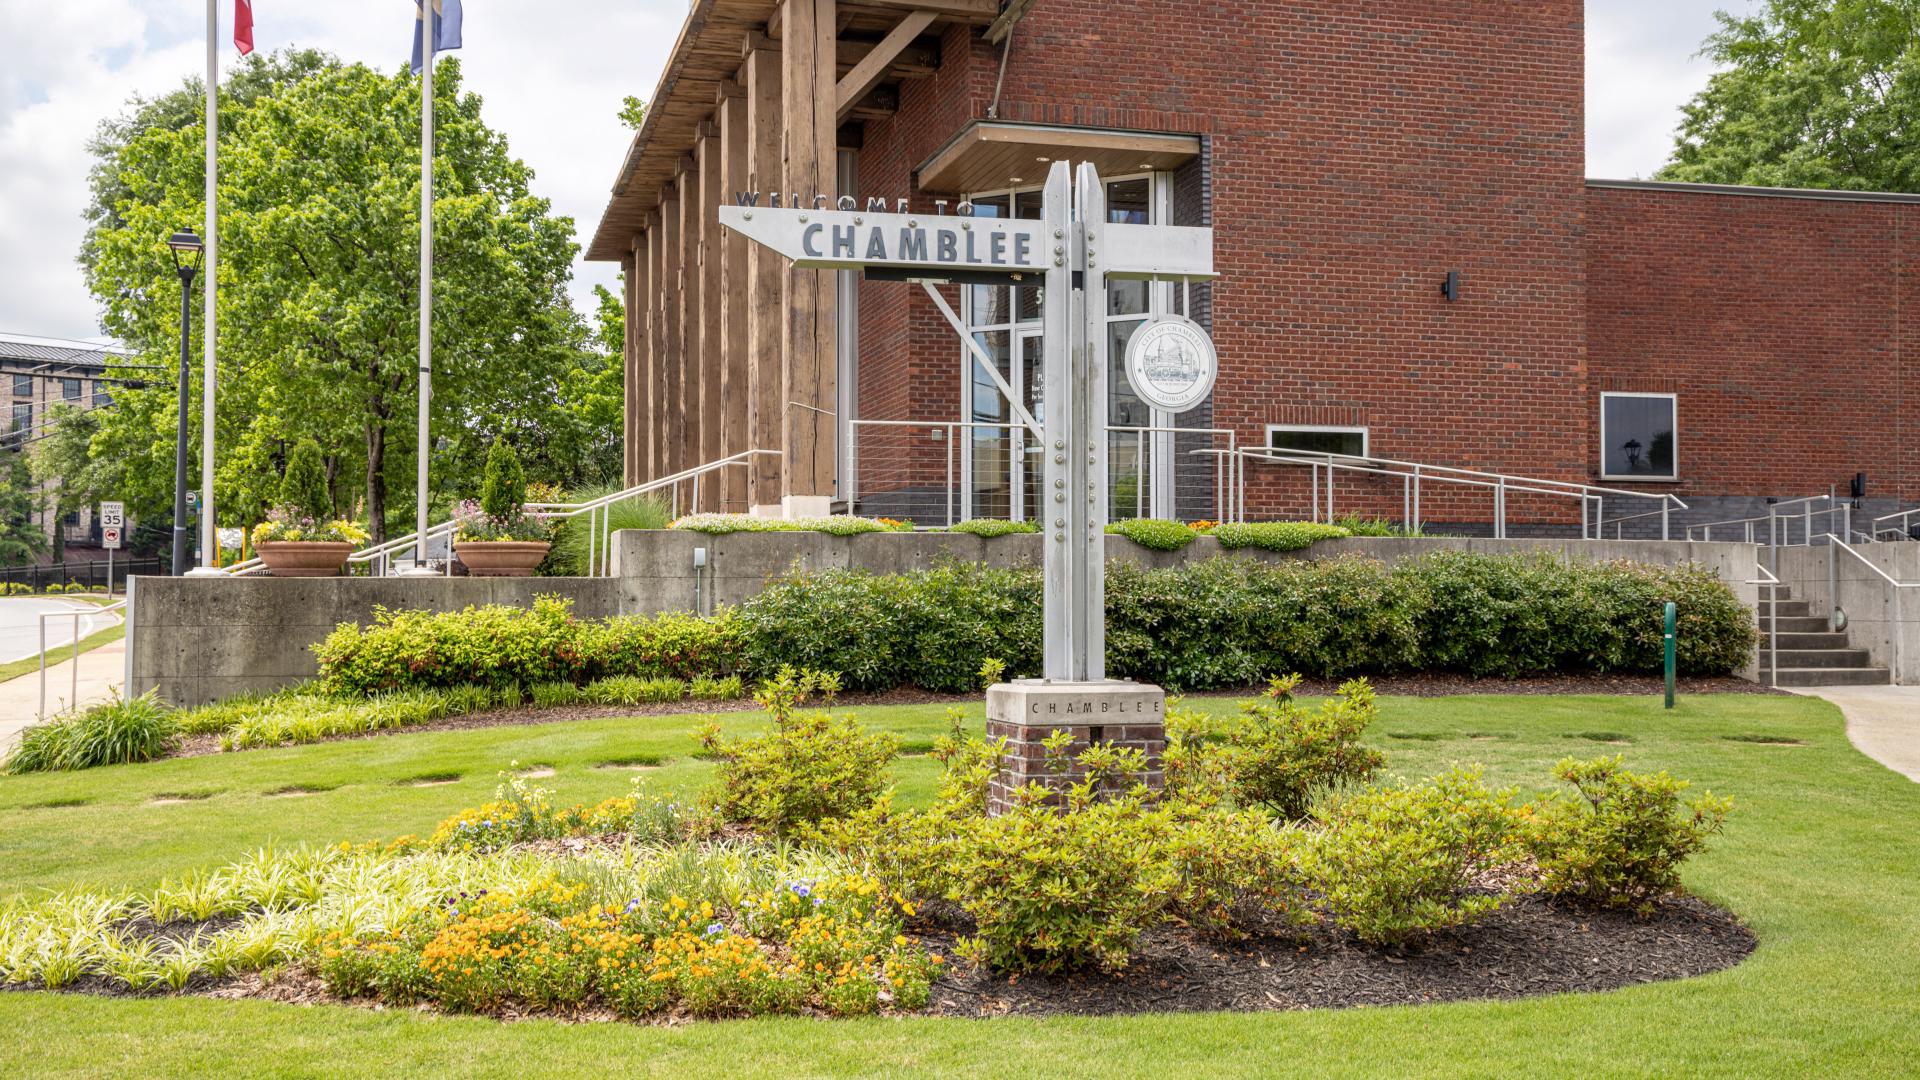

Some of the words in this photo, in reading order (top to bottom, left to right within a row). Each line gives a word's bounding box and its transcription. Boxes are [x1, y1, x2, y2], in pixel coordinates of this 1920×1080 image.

[735, 192, 909, 214] WELCOME
[936, 200, 975, 217] TO
[802, 223, 1031, 265] CHAMBLEE
[1156, 393, 1190, 401] GEORGIA
[104, 515, 121, 525] 35
[1032, 702, 1159, 714] CHAMBLEE
